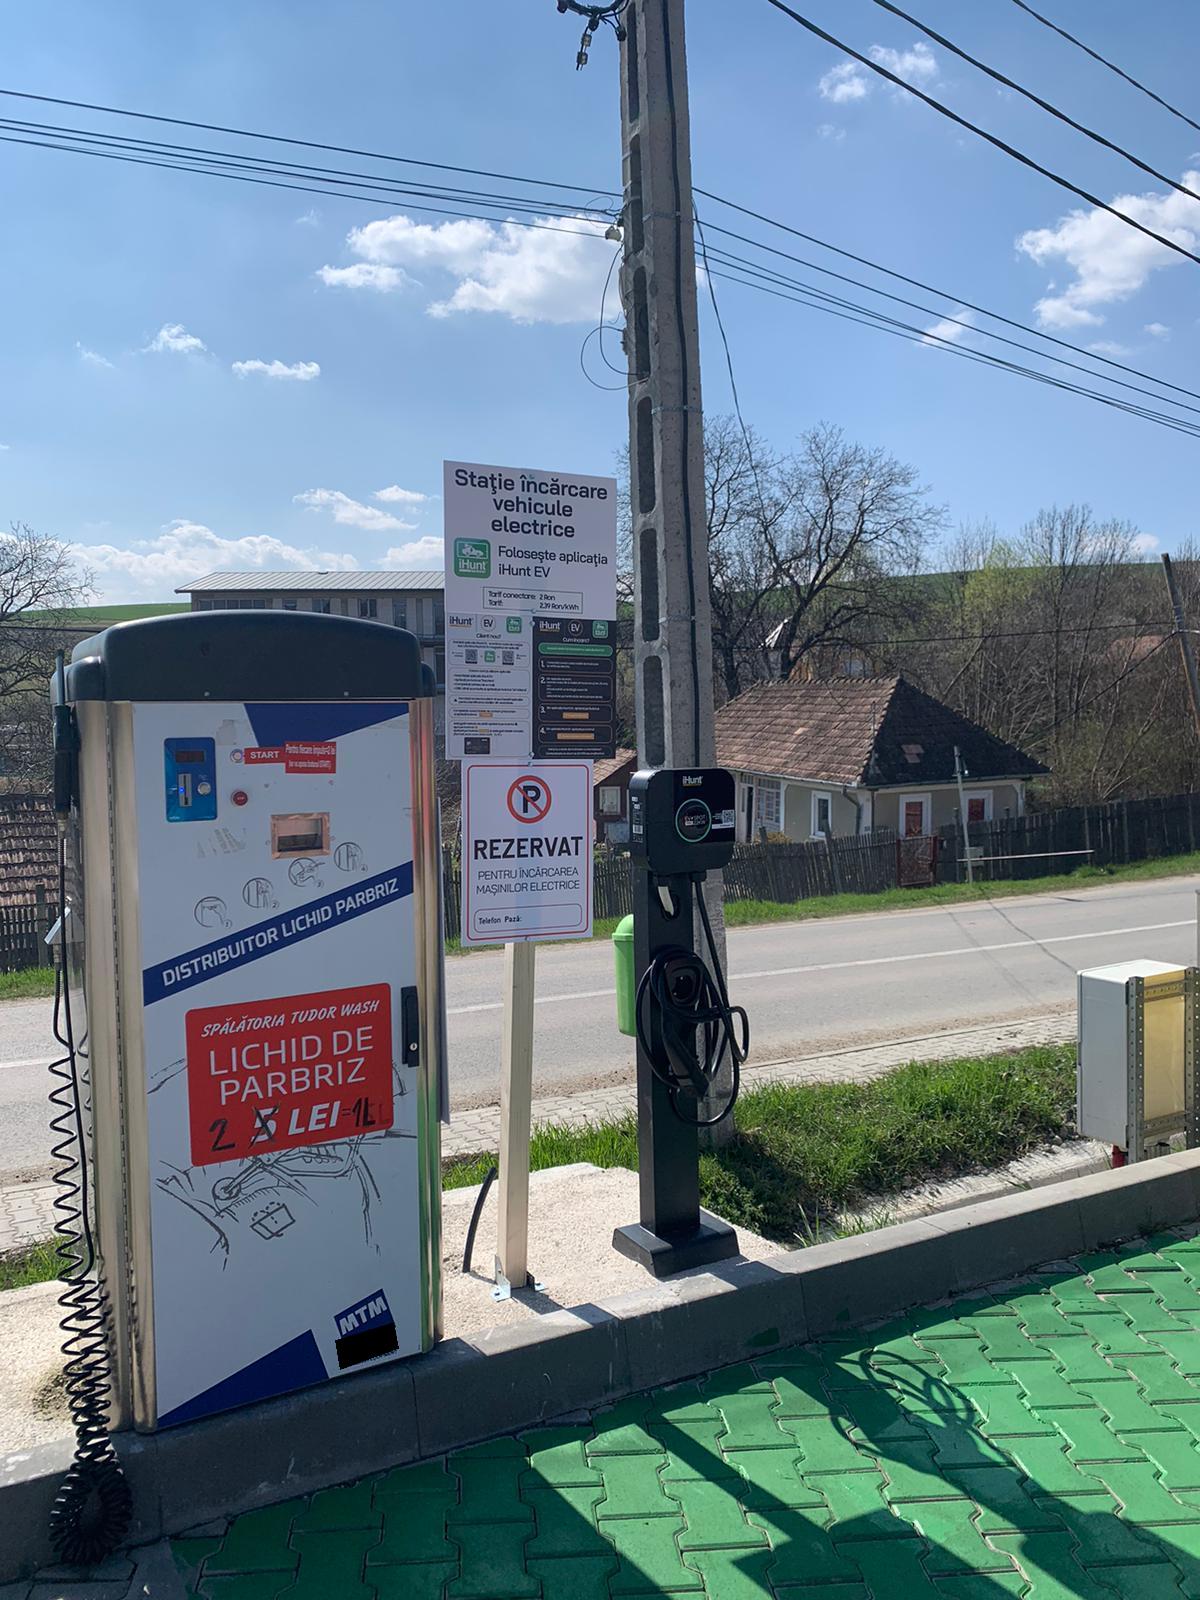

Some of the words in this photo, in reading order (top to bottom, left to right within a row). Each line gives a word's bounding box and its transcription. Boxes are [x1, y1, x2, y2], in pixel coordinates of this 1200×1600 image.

[520, 474, 608, 500] încărcare
[493, 496, 573, 517] vehicule
[491, 516, 575, 537] electrice
[458, 558, 486, 570] iHunt
[498, 563, 531, 577] iHunt
[534, 566, 550, 578] EV
[488, 590, 502, 598] Tarif
[449, 615, 472, 626] iHunt
[483, 619, 494, 627] EV
[540, 620, 561, 630] iHunt
[570, 623, 580, 632] EV
[250, 751, 280, 759] START
[682, 775, 703, 785] iHunt
[474, 836, 583, 860] REZERVAT
[478, 869, 517, 880] PENTRU
[530, 880, 580, 891] ELECTRICE
[478, 916, 501, 925] Telefon
[162, 927, 278, 986] DISTRIBUITOR
[281, 906, 332, 937] LICHID
[335, 877, 399, 916] PARBRIZ
[201, 1014, 285, 1038] SPĂLĂTORIA
[291, 1006, 337, 1024] TUDOR
[341, 1000, 380, 1017] WASH
[209, 1035, 322, 1076] LICHID
[333, 1025, 373, 1056] DE
[220, 1057, 366, 1105] PARBRIZ
[208, 1118, 235, 1151] 2
[288, 1100, 341, 1136] LEI
[339, 1296, 387, 1335] MTM
